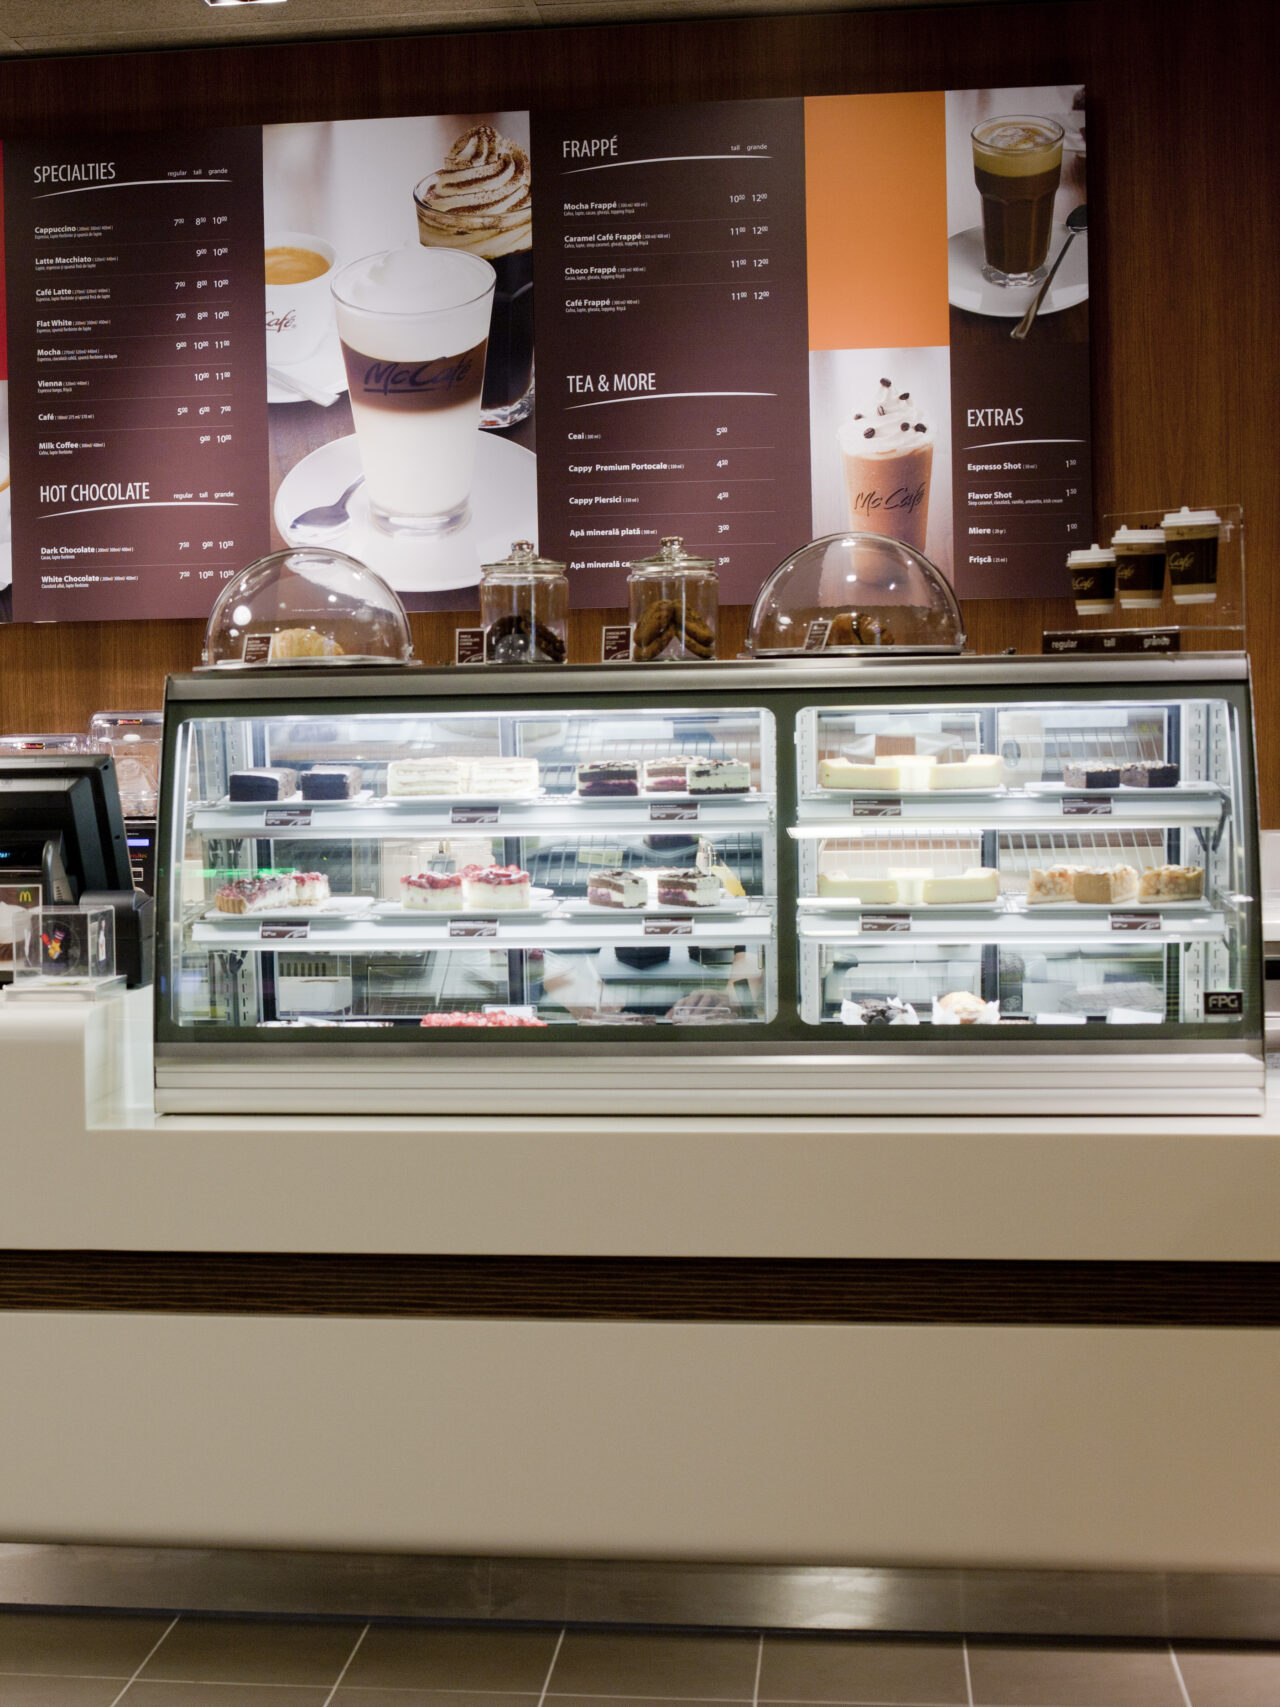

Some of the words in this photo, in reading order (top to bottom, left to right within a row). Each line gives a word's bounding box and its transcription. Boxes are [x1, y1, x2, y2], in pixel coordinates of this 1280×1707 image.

[563, 135, 618, 158] FRAPPÉ
[34, 162, 115, 183] SPECIALTIES
[590, 201, 616, 211] Frappé
[35, 225, 76, 234] Cappuccino
[564, 234, 595, 242] Caramel
[616, 232, 641, 242] Frappé
[590, 265, 616, 276] Frappé
[584, 298, 610, 308] Frappé
[364, 355, 472, 394] McCafé
[567, 375, 594, 392] TEA
[598, 375, 609, 392] &
[614, 373, 656, 391] MORE
[967, 408, 1023, 427] EXTRAS
[568, 465, 592, 473] Cappy
[631, 462, 667, 470] Portocale
[968, 464, 1001, 472] Espresso
[40, 485, 67, 502] HOT
[71, 482, 150, 501] CHOCOLATE
[214, 491, 234, 499] grande
[569, 497, 593, 505] Cappy
[1052, 640, 1077, 649] regular
[1104, 638, 1115, 647] tall
[1144, 637, 1169, 647] grande
[1208, 995, 1238, 1008] FPG
